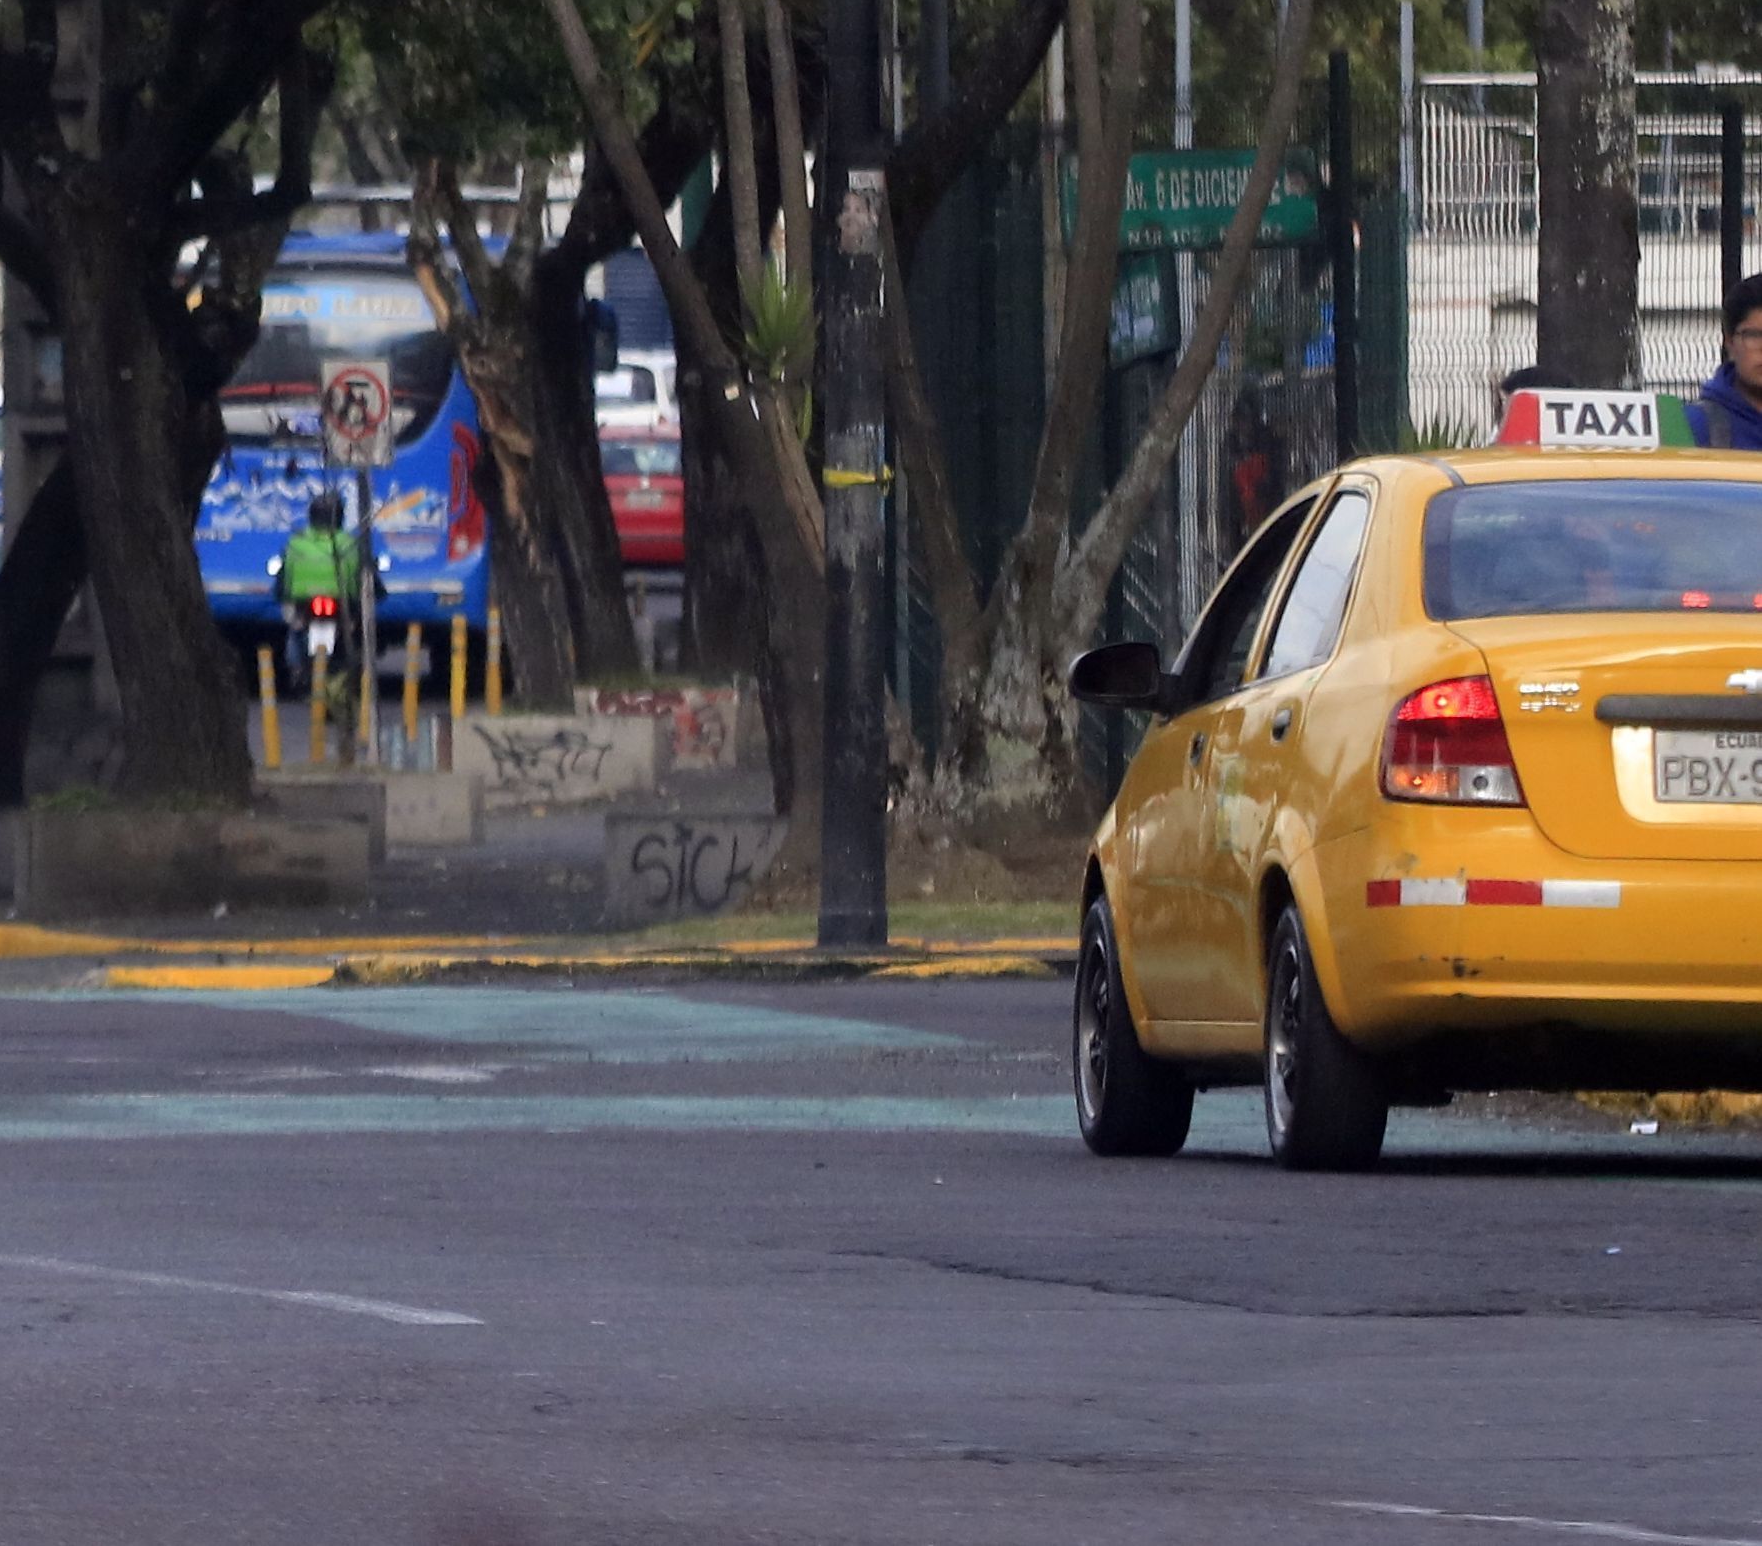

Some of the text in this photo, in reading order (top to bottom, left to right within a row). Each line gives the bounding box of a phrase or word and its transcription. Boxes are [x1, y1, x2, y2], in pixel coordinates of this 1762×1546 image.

[1156, 168, 1165, 211] 6
[1170, 167, 1191, 209] DE
[1194, 165, 1283, 207] DICIEME
[1545, 402, 1654, 437] TAXI
